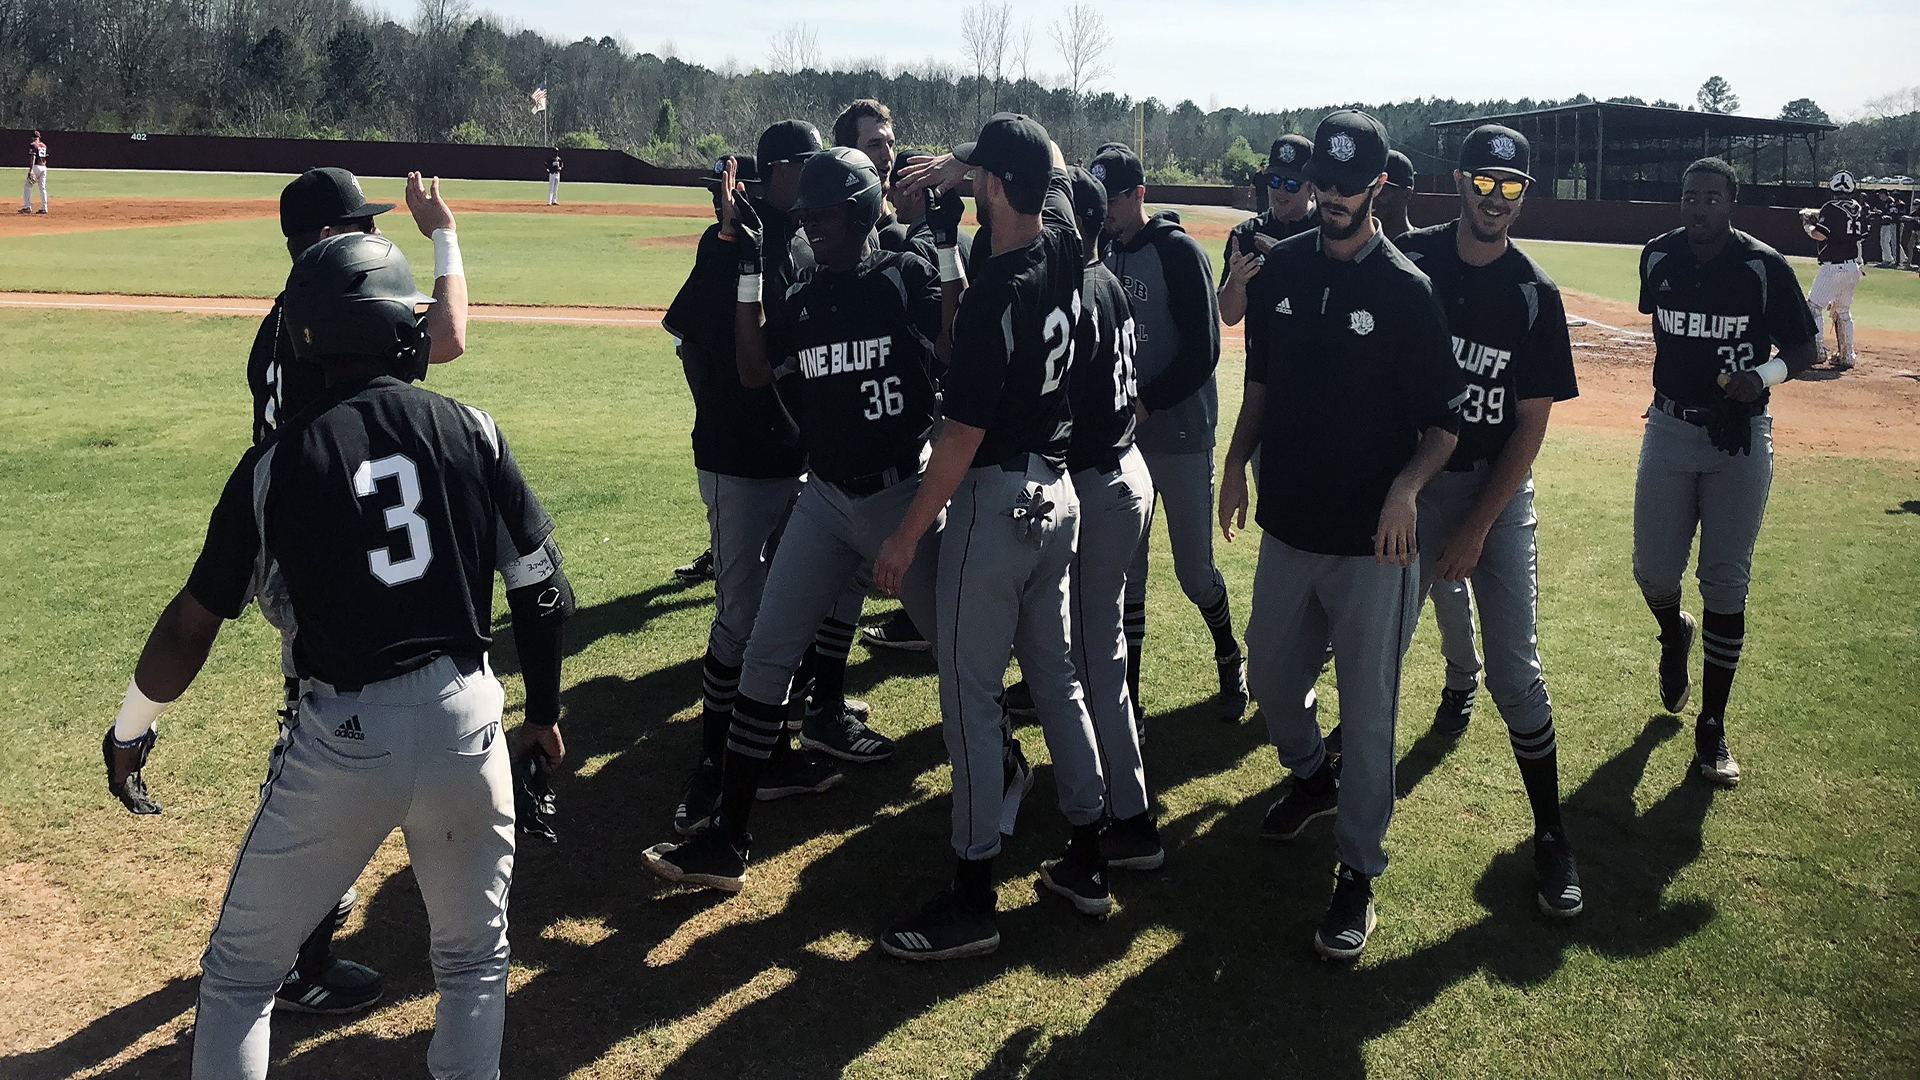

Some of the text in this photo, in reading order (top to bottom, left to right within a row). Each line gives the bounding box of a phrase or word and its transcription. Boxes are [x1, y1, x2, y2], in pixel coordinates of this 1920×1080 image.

[131, 133, 147, 141] 402
[1687, 312, 1750, 340] BLUFF
[830, 335, 893, 375] BLUFF
[1717, 342, 1755, 375] 32
[860, 376, 904, 421] 36
[1463, 384, 1505, 424] 39
[353, 452, 434, 588] 3
[334, 728, 366, 742] adidas
